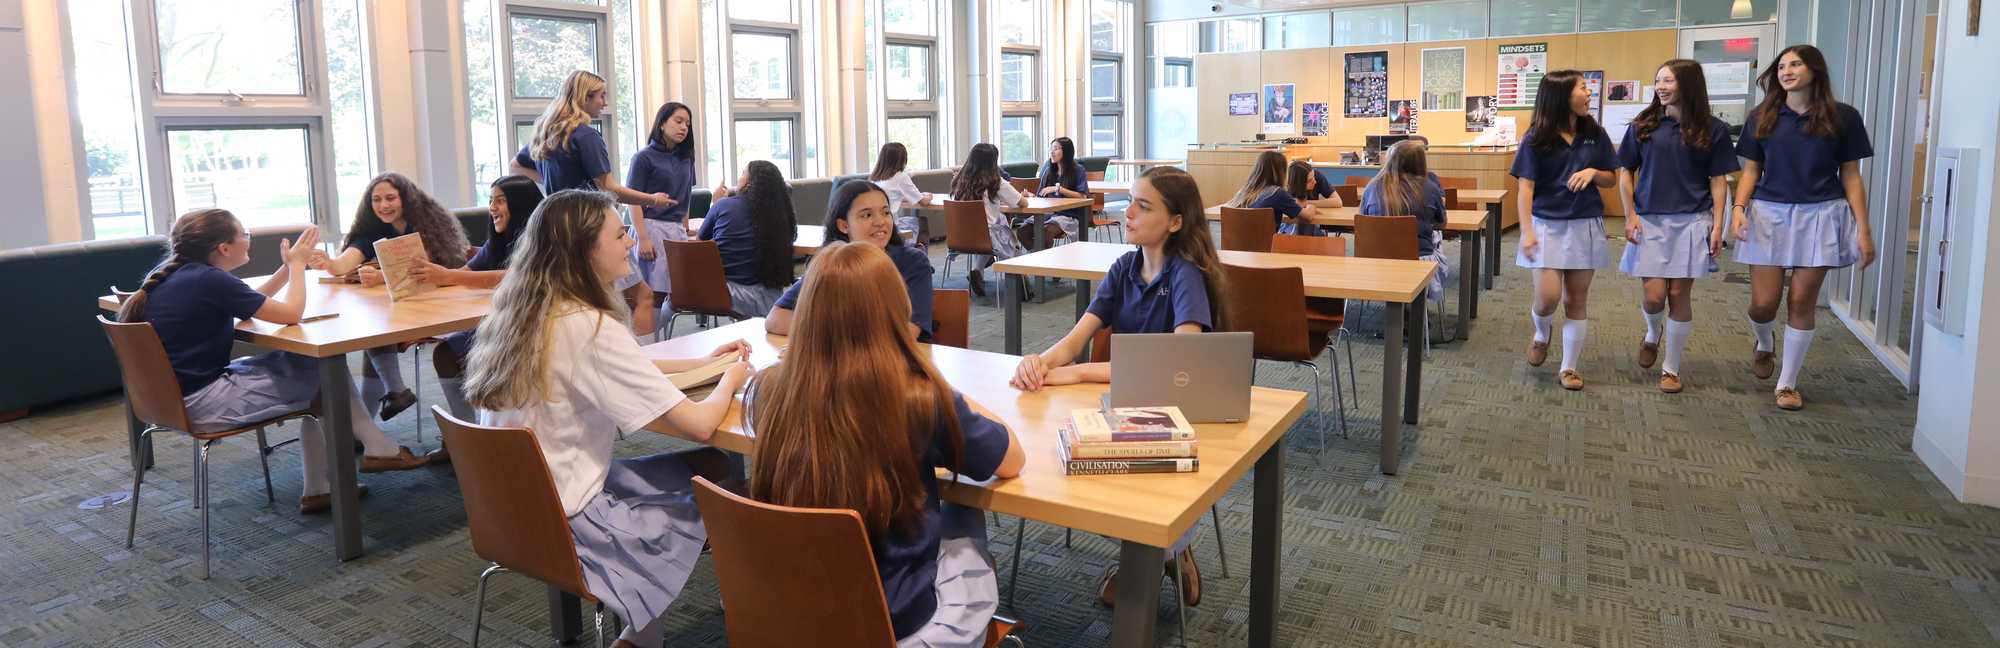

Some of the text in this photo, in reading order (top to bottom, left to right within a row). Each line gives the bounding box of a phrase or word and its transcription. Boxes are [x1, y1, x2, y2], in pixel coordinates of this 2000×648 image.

[1500, 44, 1545, 53] MINDSETS
[1320, 101, 1328, 136] SCIENCE
[1070, 461, 1129, 470] CIVILISATION
